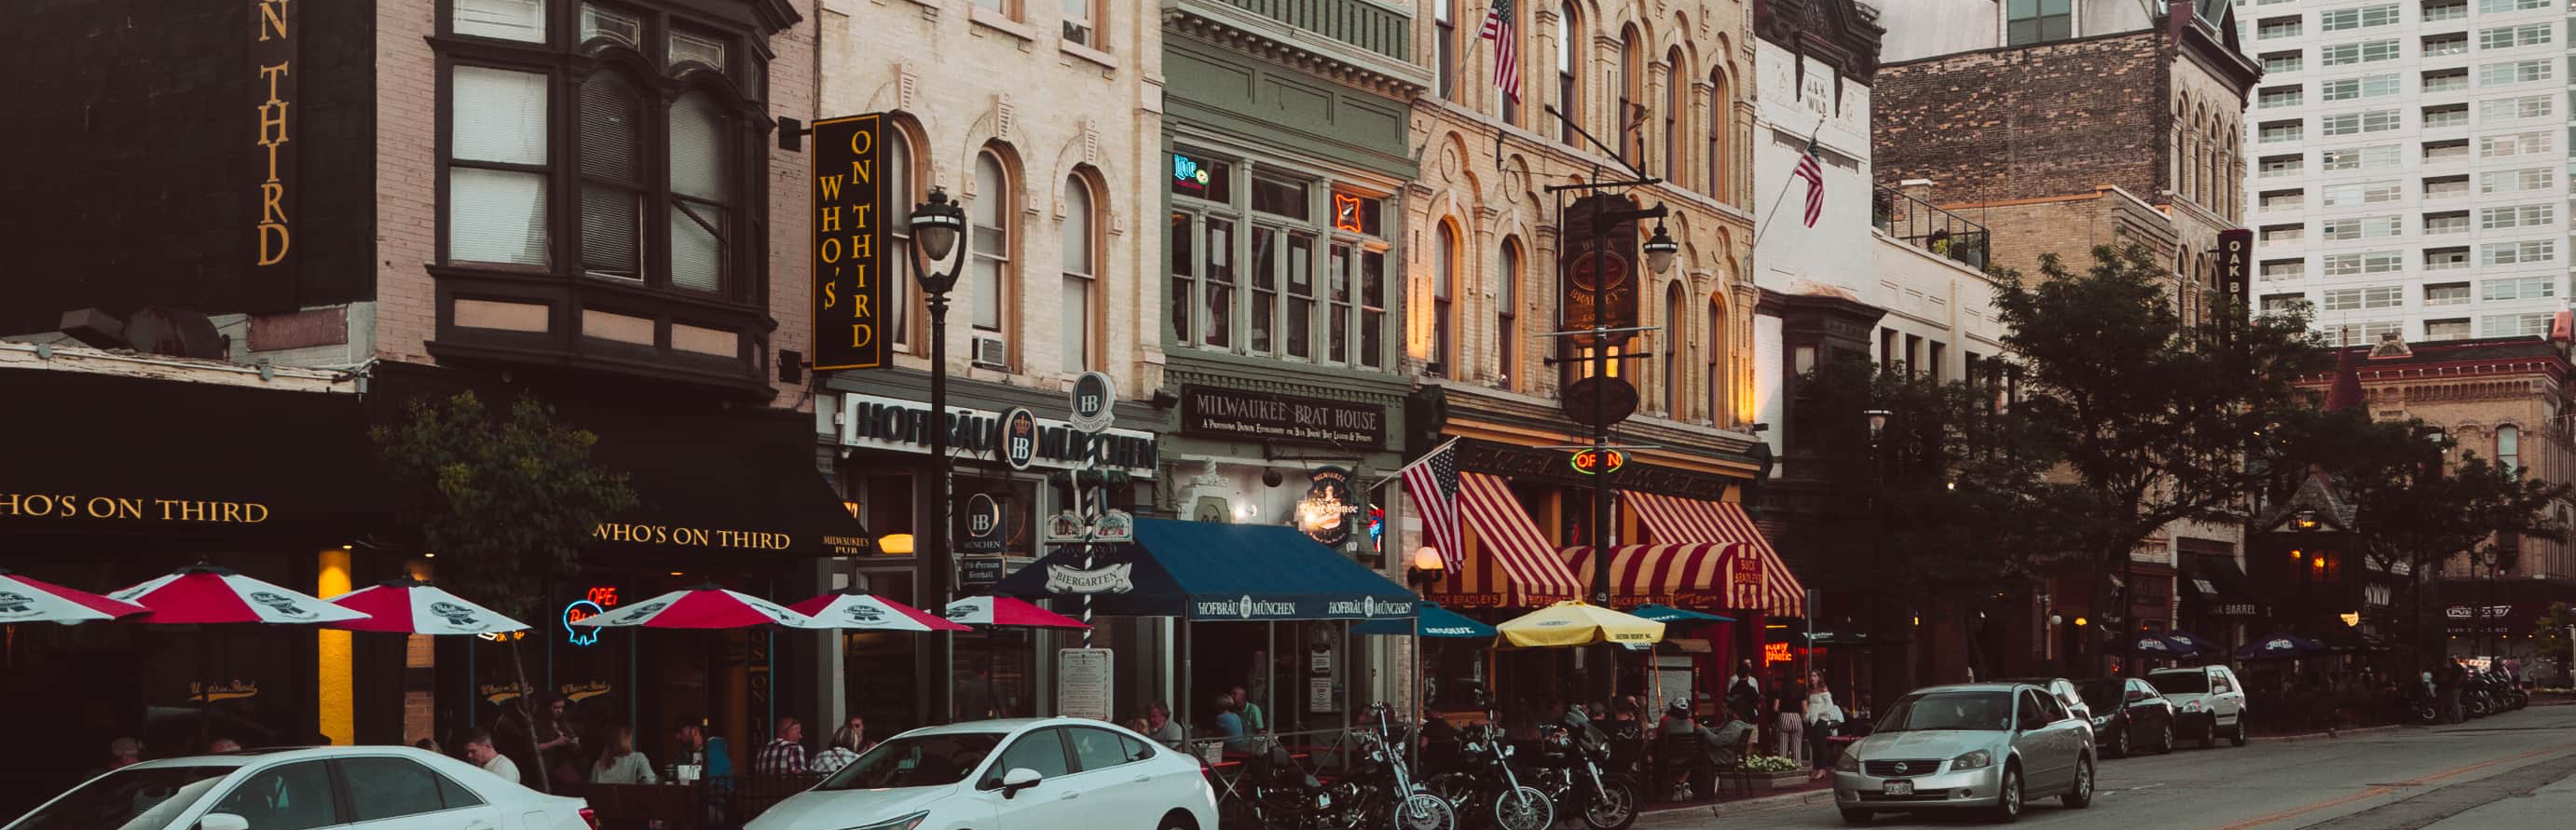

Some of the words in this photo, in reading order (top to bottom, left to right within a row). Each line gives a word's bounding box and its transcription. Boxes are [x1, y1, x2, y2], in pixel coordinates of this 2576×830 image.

[259, 0, 290, 41] N
[257, 61, 290, 266] THIRD
[851, 129, 871, 184] ON
[819, 174, 843, 310] WHO'S
[2228, 239, 2241, 278] OAK
[851, 202, 872, 347] THIRD
[1081, 394, 1098, 413] HB
[1197, 394, 1286, 420] MILWAUKEE
[1295, 404, 1329, 426] BRAT
[1336, 408, 1377, 430] HOUSE
[857, 401, 995, 451] HOFRÄU
[1012, 437, 1029, 459] HB
[1576, 454, 1620, 468] OPN
[88, 497, 142, 520] ON
[155, 499, 268, 523] THIRD
[972, 514, 989, 530] HB
[592, 522, 666, 544] WHO'S
[673, 527, 709, 547] ON
[717, 530, 790, 551] THIRD
[835, 546, 857, 554] PUB
[1056, 570, 1117, 588] BIERGARTEN
[1198, 599, 1239, 615] HOFBRÄU
[1252, 599, 1295, 615] MÜNCHEN
[1328, 598, 1363, 614] HOFBRÄU
[2225, 604, 2256, 615] BARREL
